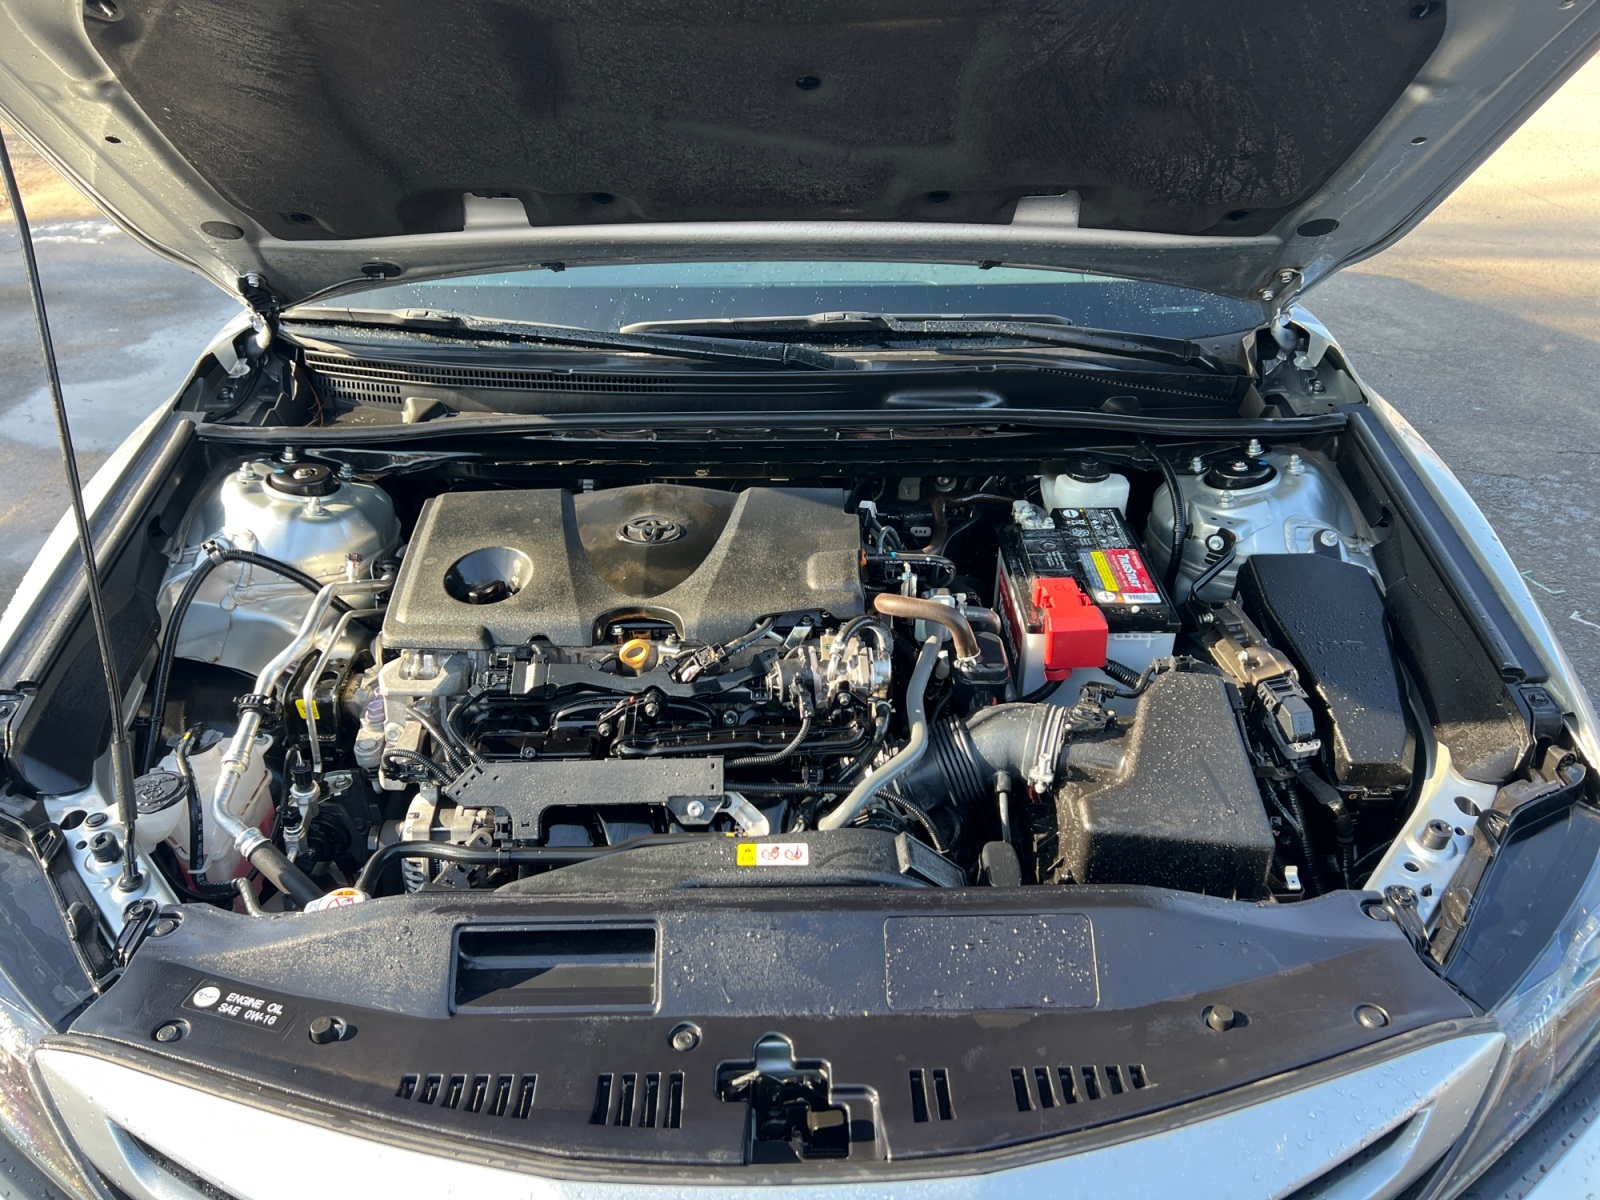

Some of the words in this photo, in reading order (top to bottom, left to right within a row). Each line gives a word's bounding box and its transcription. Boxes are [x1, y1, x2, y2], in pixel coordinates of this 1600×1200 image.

[218, 1003, 241, 1016] SAE
[244, 1010, 277, 1025] 0W-16
[226, 993, 265, 1009] ENGINE
[267, 1003, 283, 1015] OIL
